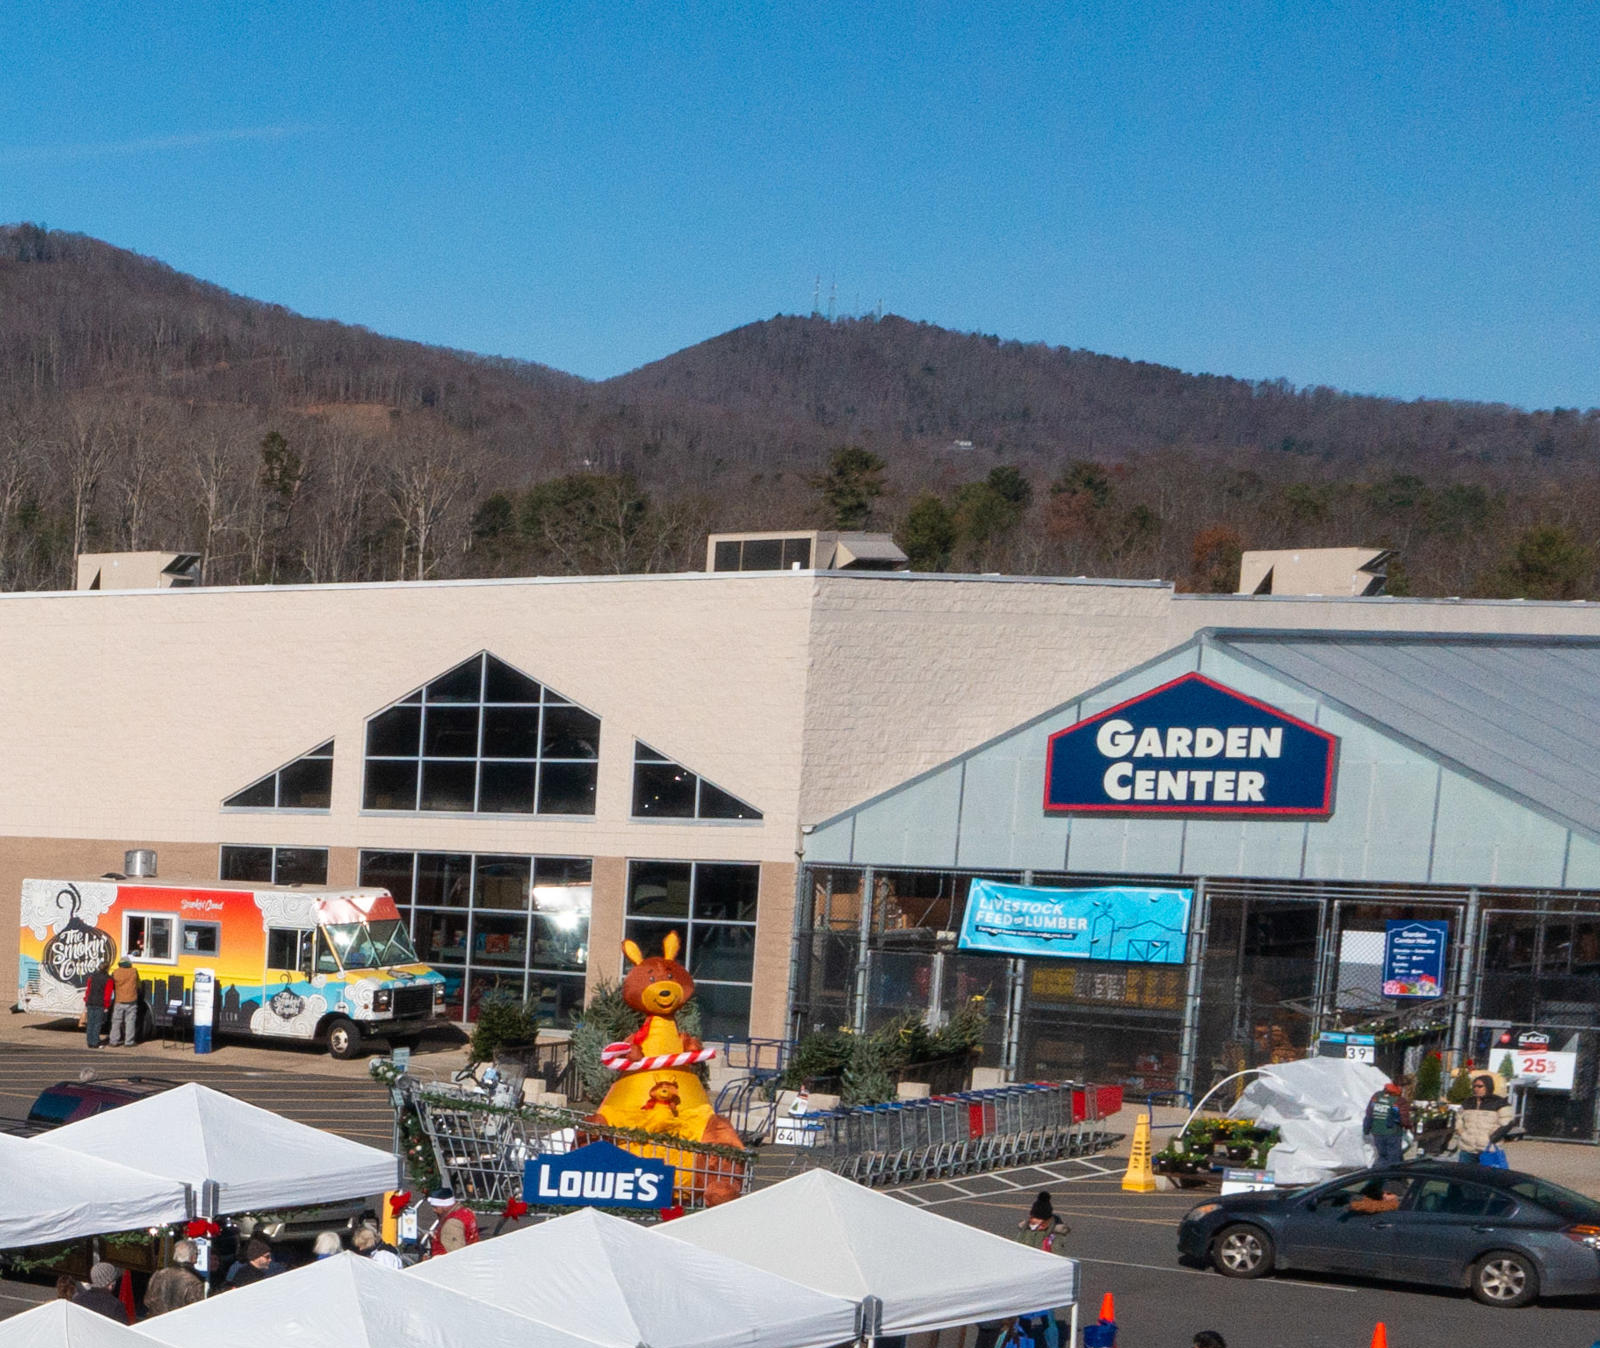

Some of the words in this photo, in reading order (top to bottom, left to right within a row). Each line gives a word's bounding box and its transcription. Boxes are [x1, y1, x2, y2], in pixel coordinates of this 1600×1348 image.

[1097, 719, 1283, 758] GARDEN
[1104, 761, 1265, 802] CENTER
[979, 898, 1064, 916] LIVESTOCK
[975, 911, 1013, 926] FEED
[1024, 916, 1089, 930] LUMBER
[60, 929, 84, 945] The
[52, 933, 108, 965] Smokin'
[1348, 1048, 1367, 1060] 39
[1522, 1058, 1547, 1073] 25
[778, 1130, 794, 1142] 64
[539, 1164, 660, 1202] LOWE'S
